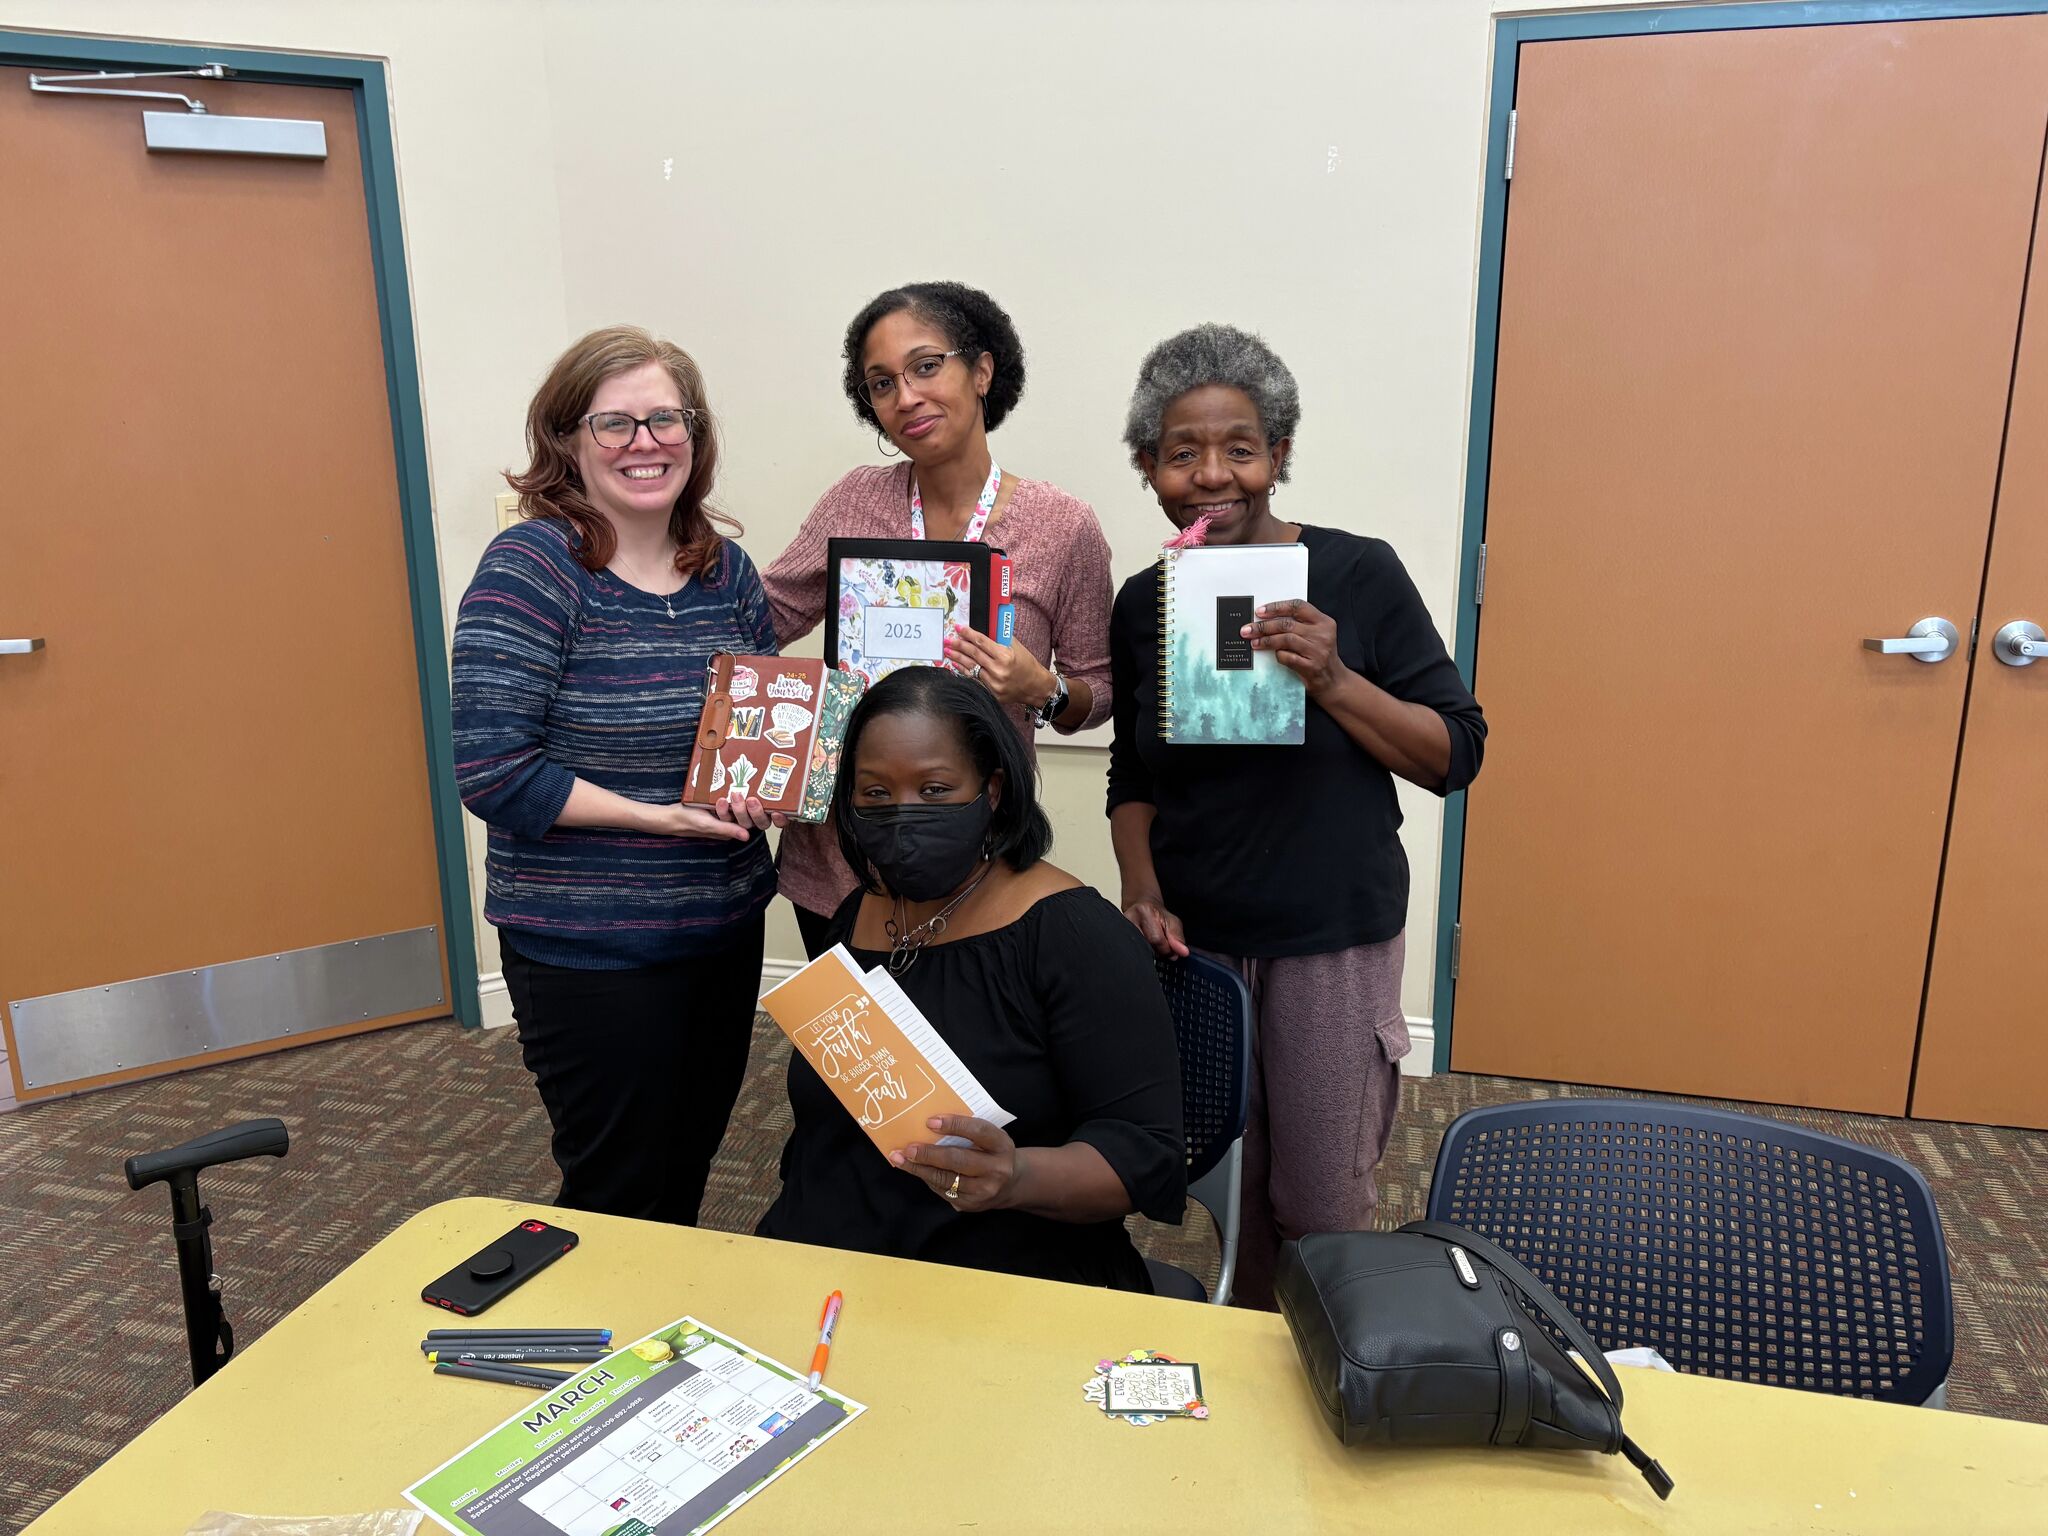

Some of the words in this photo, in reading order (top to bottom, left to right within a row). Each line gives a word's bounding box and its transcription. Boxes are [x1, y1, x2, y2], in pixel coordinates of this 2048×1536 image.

[884, 623, 922, 639] 2025
[809, 1020, 822, 1035] LET
[820, 1010, 841, 1028] YOUR
[810, 1008, 872, 1078] Faith
[840, 1071, 850, 1084] BE
[849, 1059, 873, 1078] BIGGER
[872, 1047, 891, 1066] THAN
[876, 1054, 898, 1072] YOUR
[854, 1071, 908, 1124] Fear
[522, 1369, 615, 1434] MARCH
[1114, 1377, 1125, 1396] EVERY
[466, 1500, 486, 1514] Must
[486, 1482, 512, 1502] register
[512, 1476, 522, 1484] for
[522, 1454, 554, 1477] programs
[554, 1442, 570, 1454] with
[470, 1503, 493, 1520] Space
[500, 1482, 526, 1501] limited.
[526, 1462, 553, 1482] Register
[561, 1440, 584, 1459] person
[590, 1427, 602, 1437] call
[496, 1458, 523, 1477] Monday
